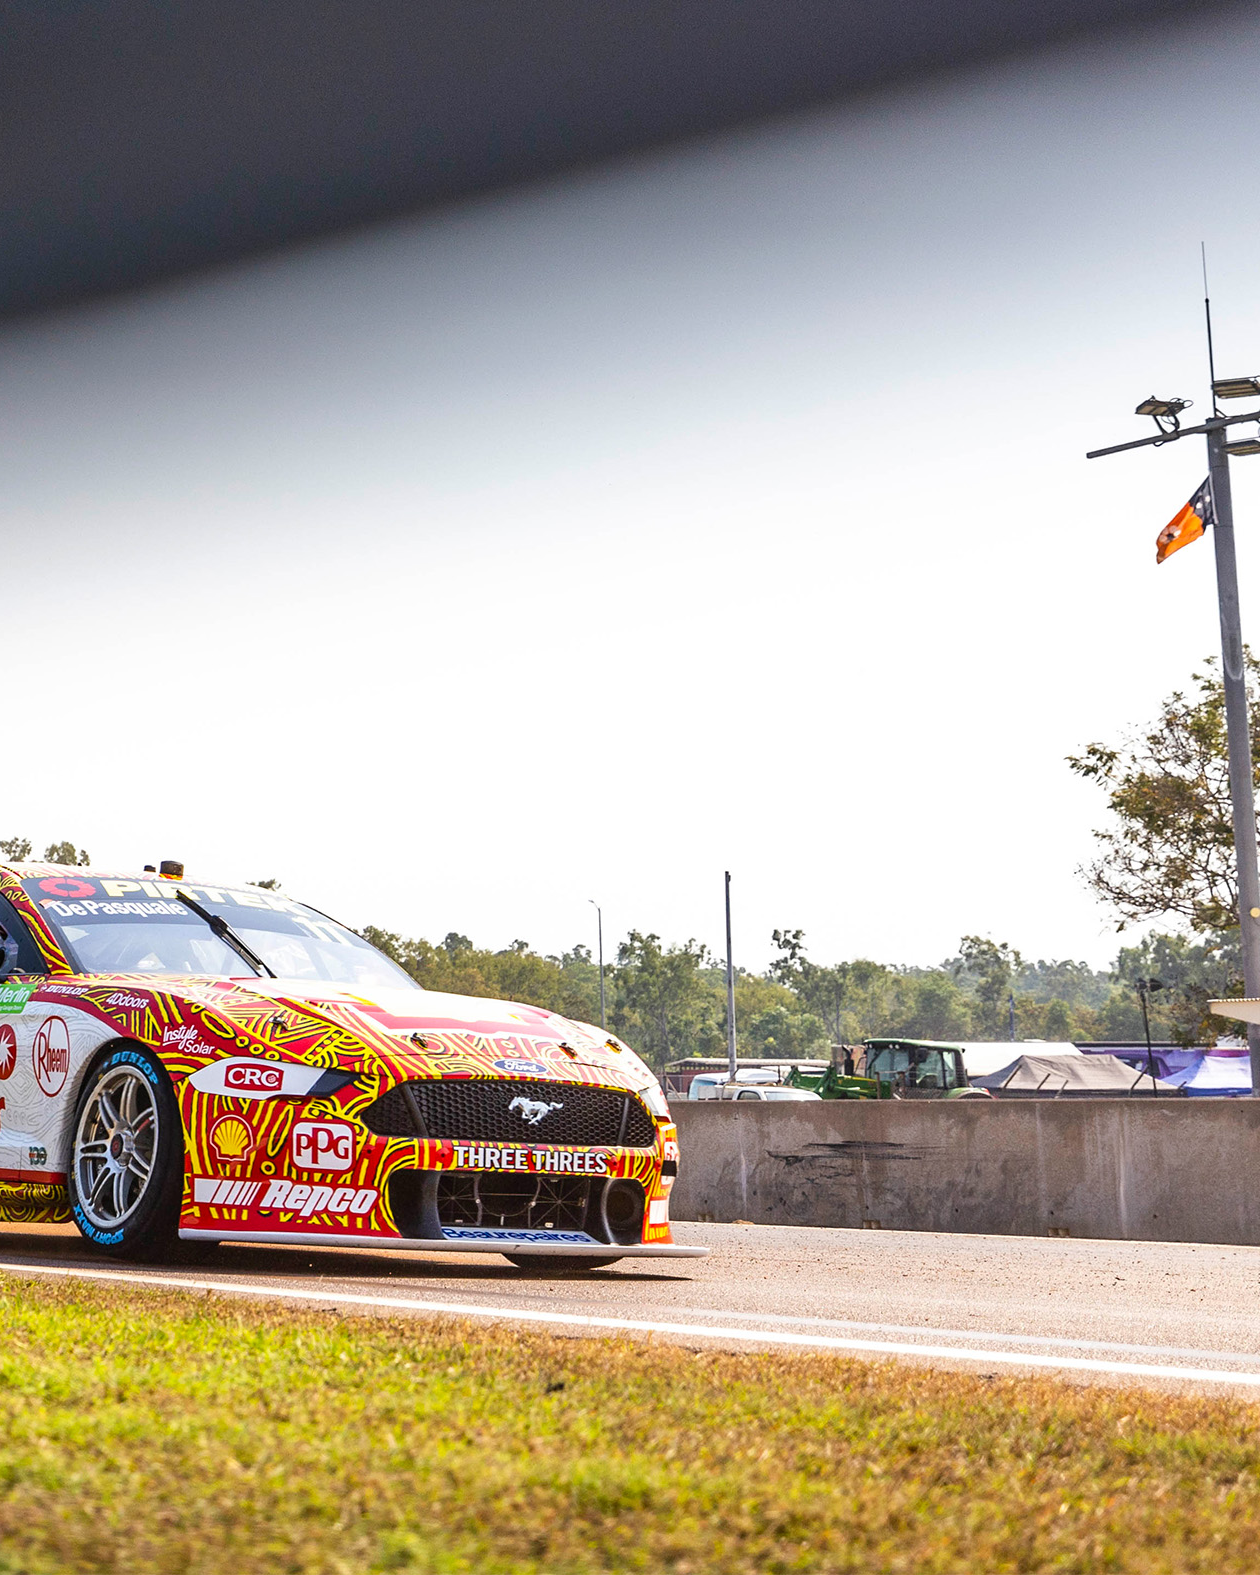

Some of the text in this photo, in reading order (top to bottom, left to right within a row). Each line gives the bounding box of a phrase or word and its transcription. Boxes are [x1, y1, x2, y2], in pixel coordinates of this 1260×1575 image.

[100, 879, 312, 918] PIRTEK
[45, 985, 89, 995] DUNLOP
[162, 1025, 198, 1050] Instyle
[184, 1040, 215, 1054] Solar
[37, 1020, 67, 1083] Rheem
[110, 1051, 159, 1084] DUNLOP
[228, 1067, 280, 1087] CRC
[504, 1060, 539, 1072] Ford
[296, 1127, 350, 1165] PPG
[454, 1146, 607, 1173] THREE THREES
[259, 1179, 378, 1217] Repco
[441, 1228, 591, 1243] Beaurepaires
